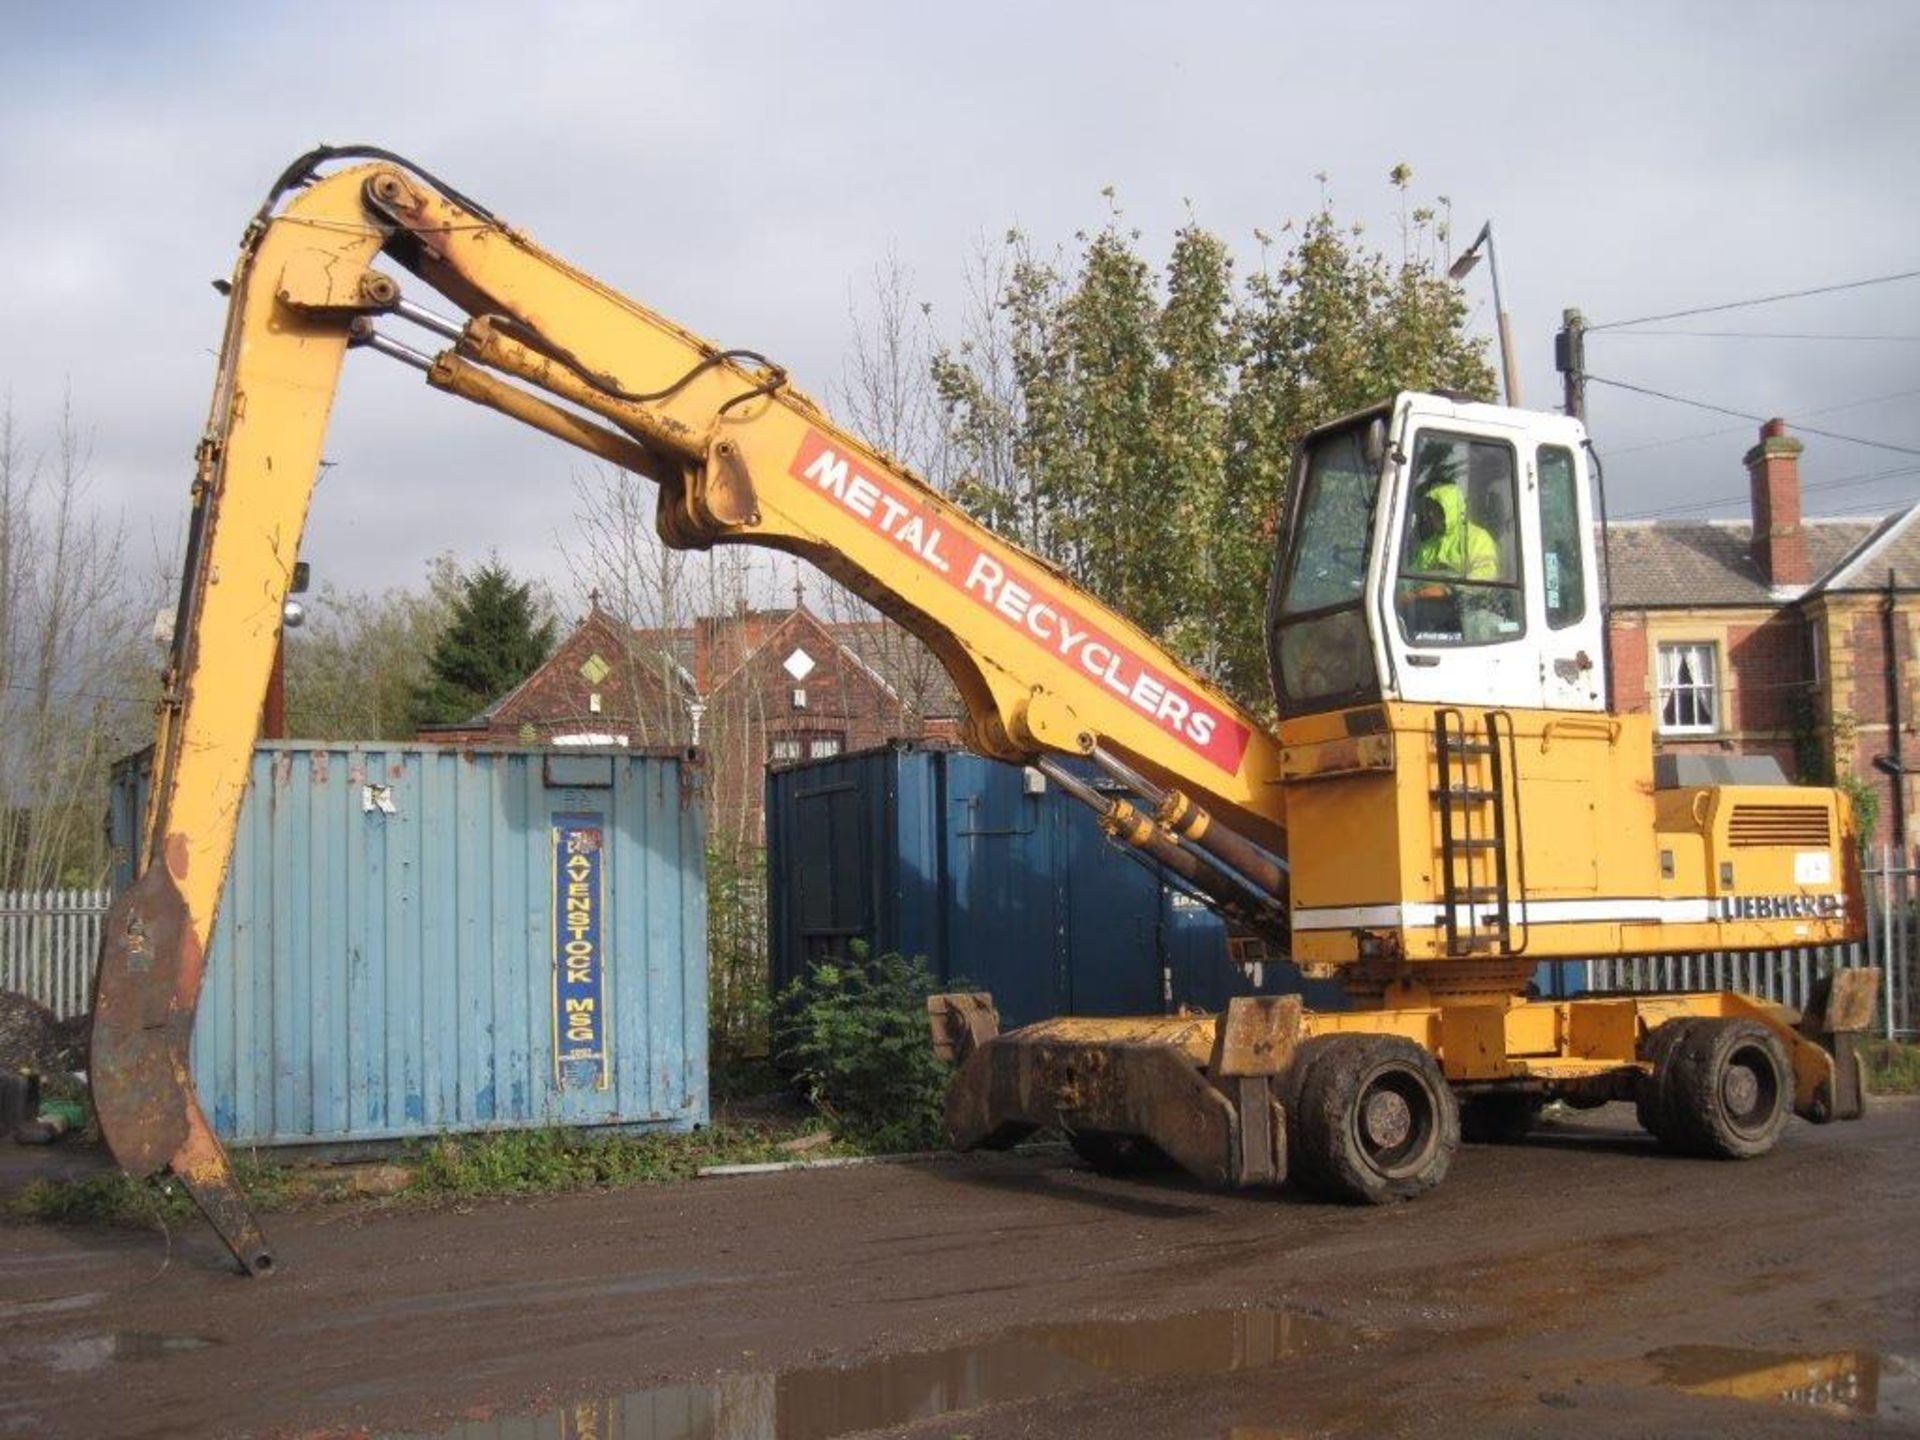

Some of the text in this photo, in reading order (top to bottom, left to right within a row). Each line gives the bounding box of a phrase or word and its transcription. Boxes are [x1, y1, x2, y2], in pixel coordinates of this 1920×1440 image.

[803, 450, 1218, 747] METAL RECYCLERS
[565, 998, 594, 1041] MSG
